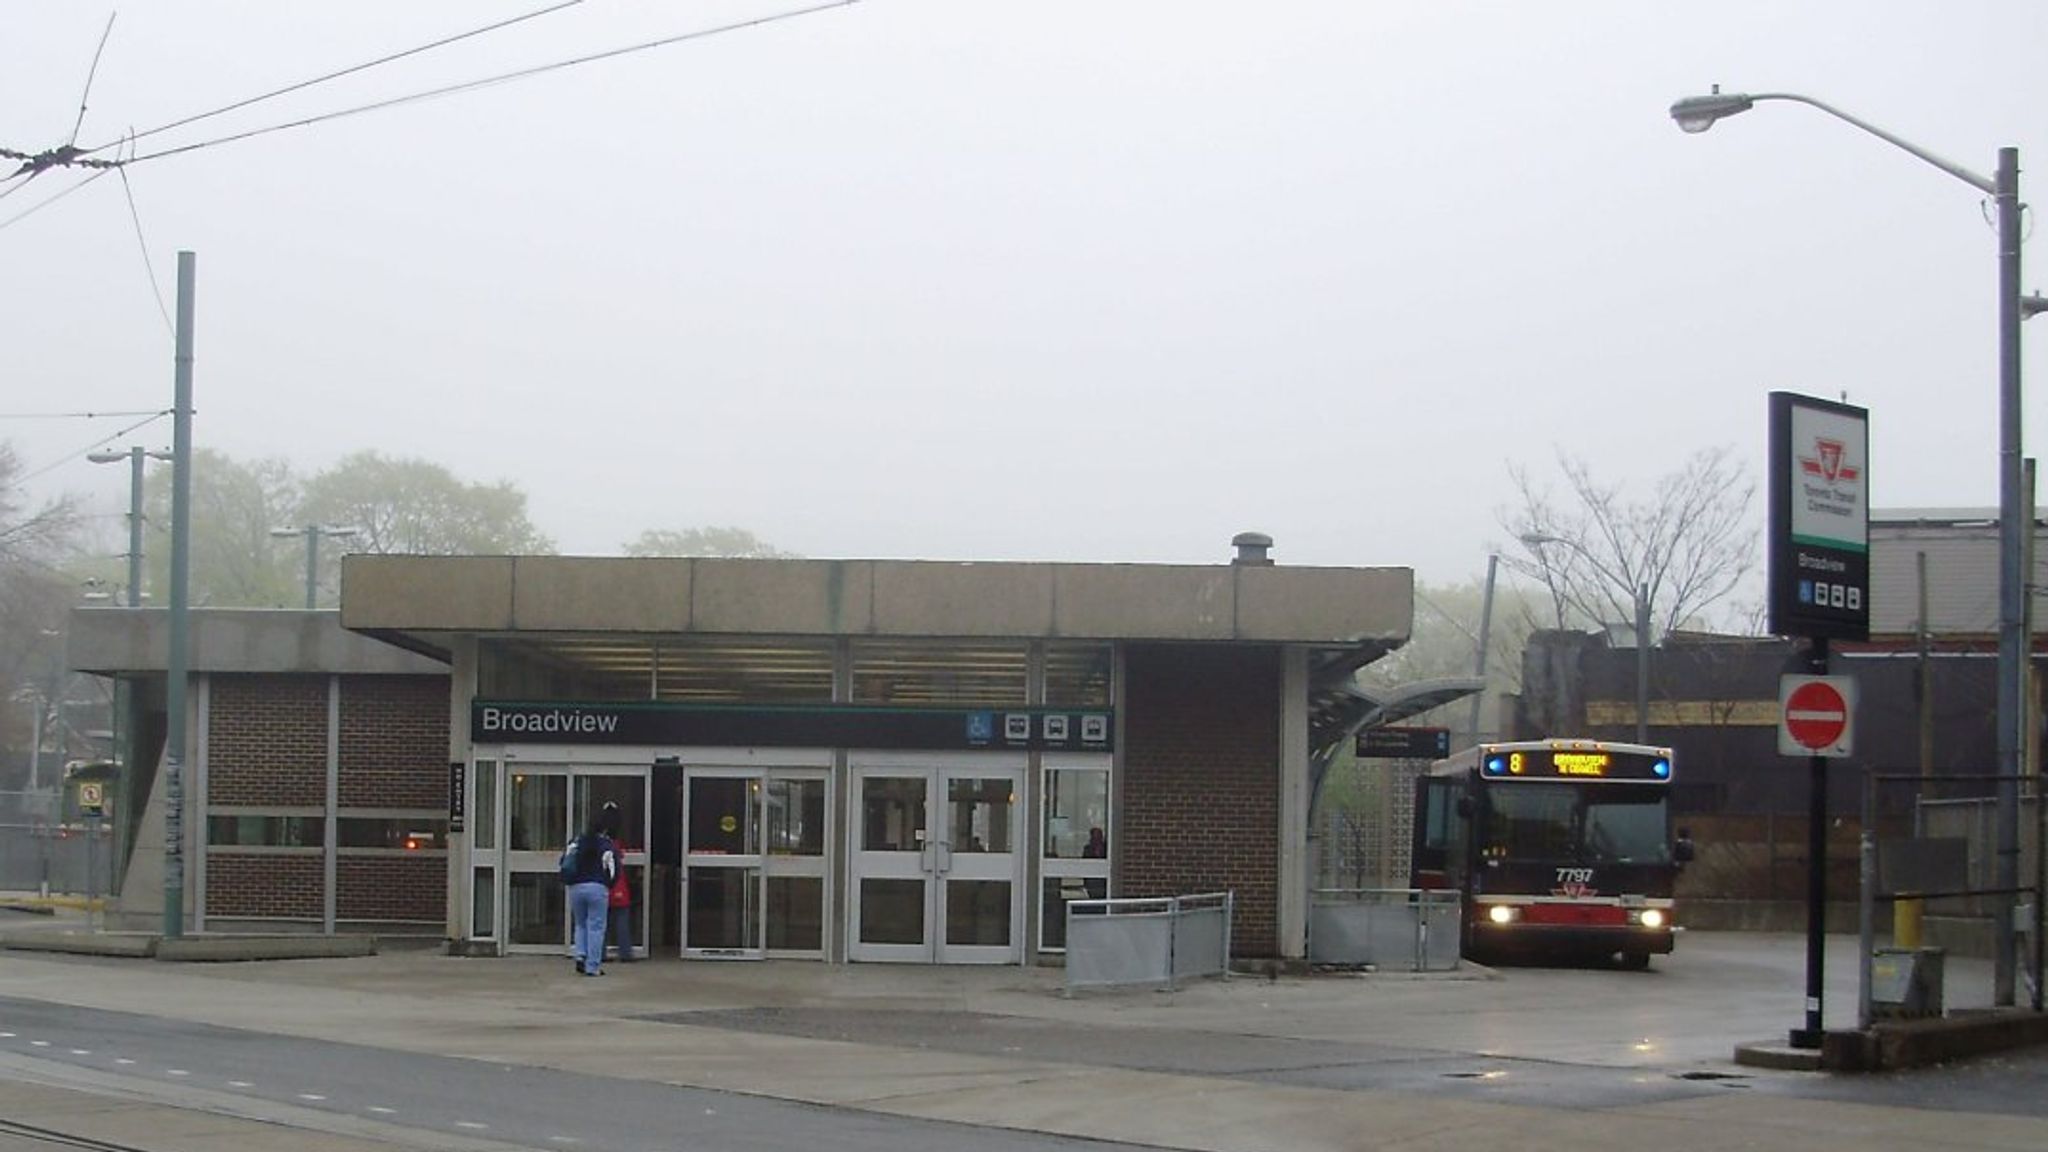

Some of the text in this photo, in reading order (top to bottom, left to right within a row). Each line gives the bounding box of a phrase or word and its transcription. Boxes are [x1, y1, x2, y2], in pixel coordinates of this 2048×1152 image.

[1799, 552, 1845, 571] Broadview
[483, 707, 618, 733] Broadview
[1510, 753, 1521, 773] 8
[1556, 868, 1593, 882] 7797
